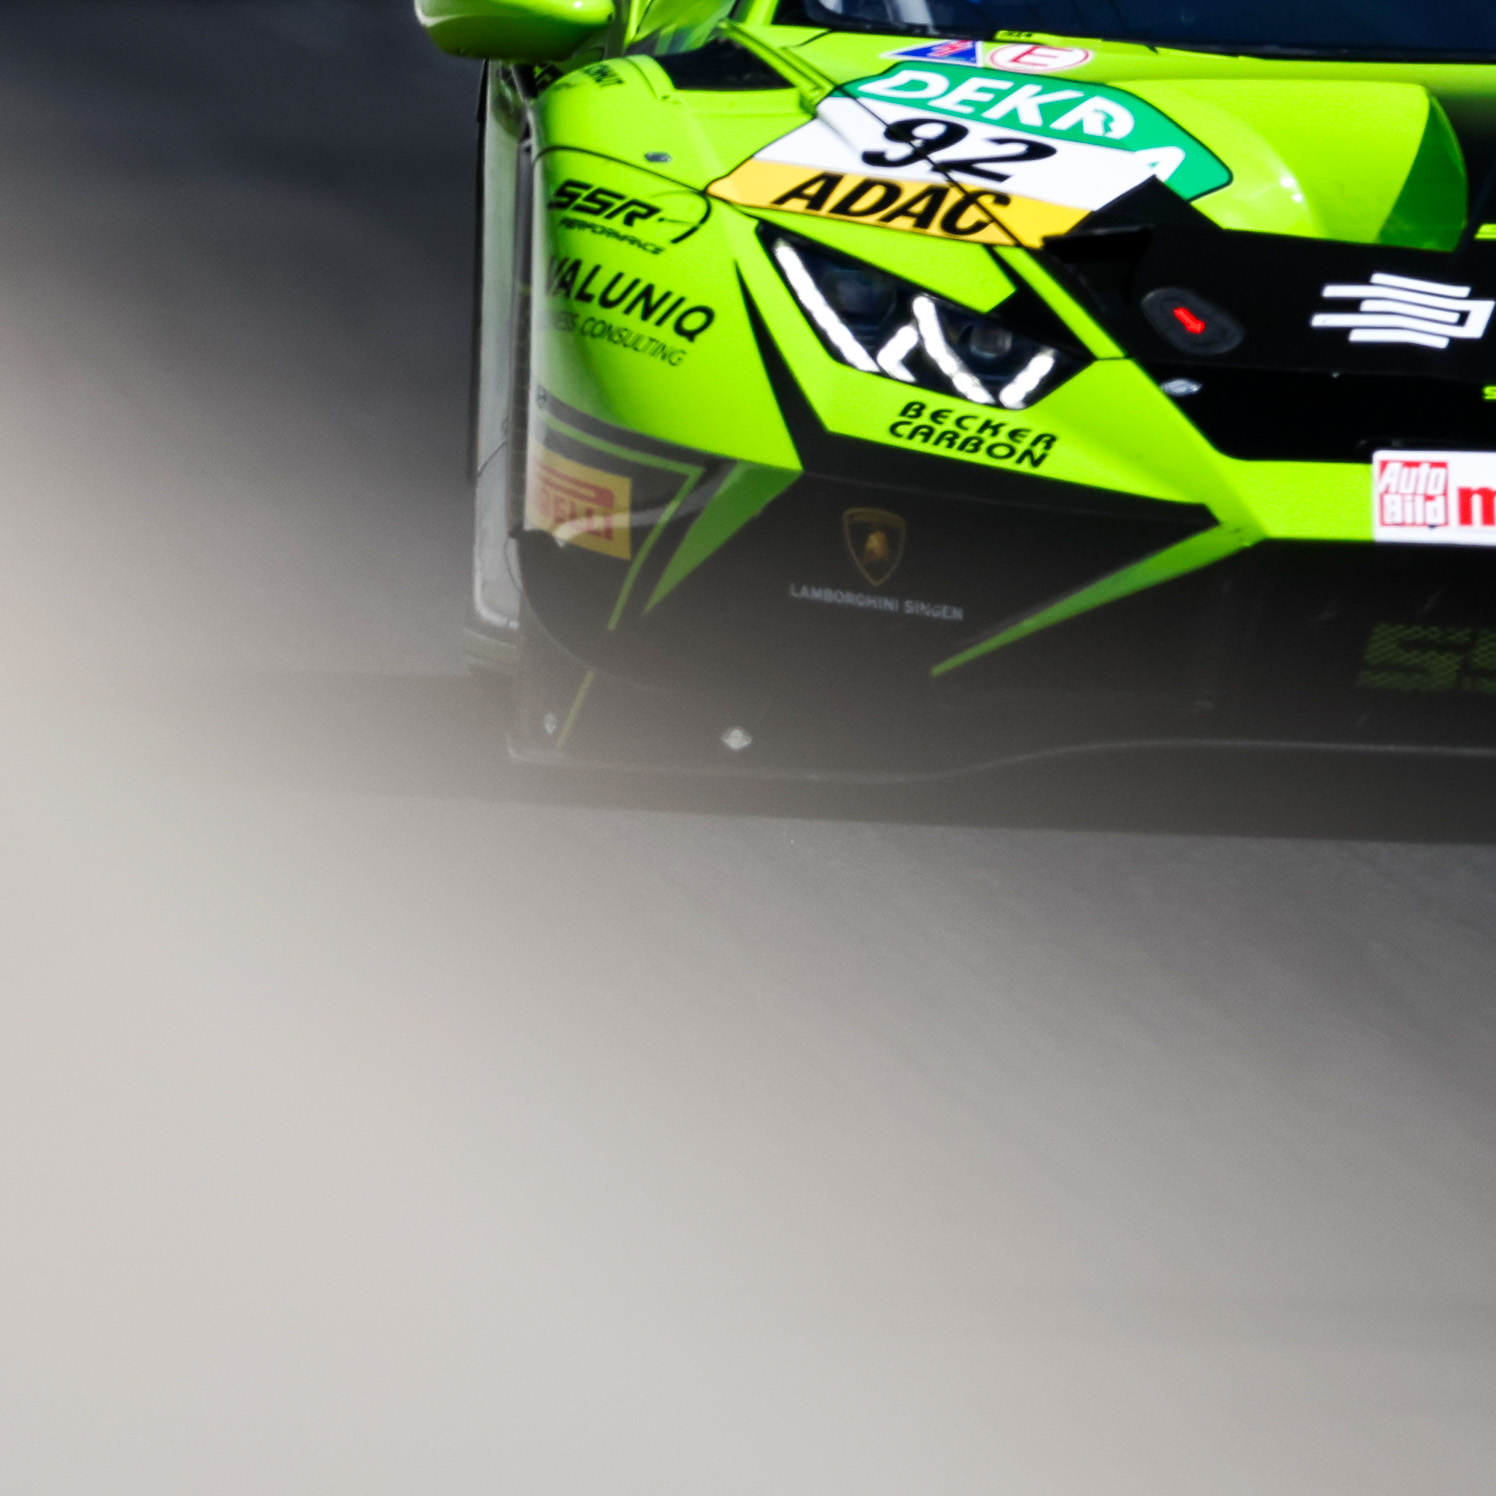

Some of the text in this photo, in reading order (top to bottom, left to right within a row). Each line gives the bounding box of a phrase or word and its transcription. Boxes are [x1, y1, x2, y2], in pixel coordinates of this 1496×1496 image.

[857, 70, 1186, 182] DEKRA
[861, 118, 1057, 182] 92
[547, 179, 662, 227] SSR
[770, 172, 1011, 235] ADAC
[546, 256, 716, 343] VALUNIQ
[889, 421, 1049, 468] CARBON
[899, 401, 1058, 451] BECKER
[1380, 461, 1447, 494] Auto
